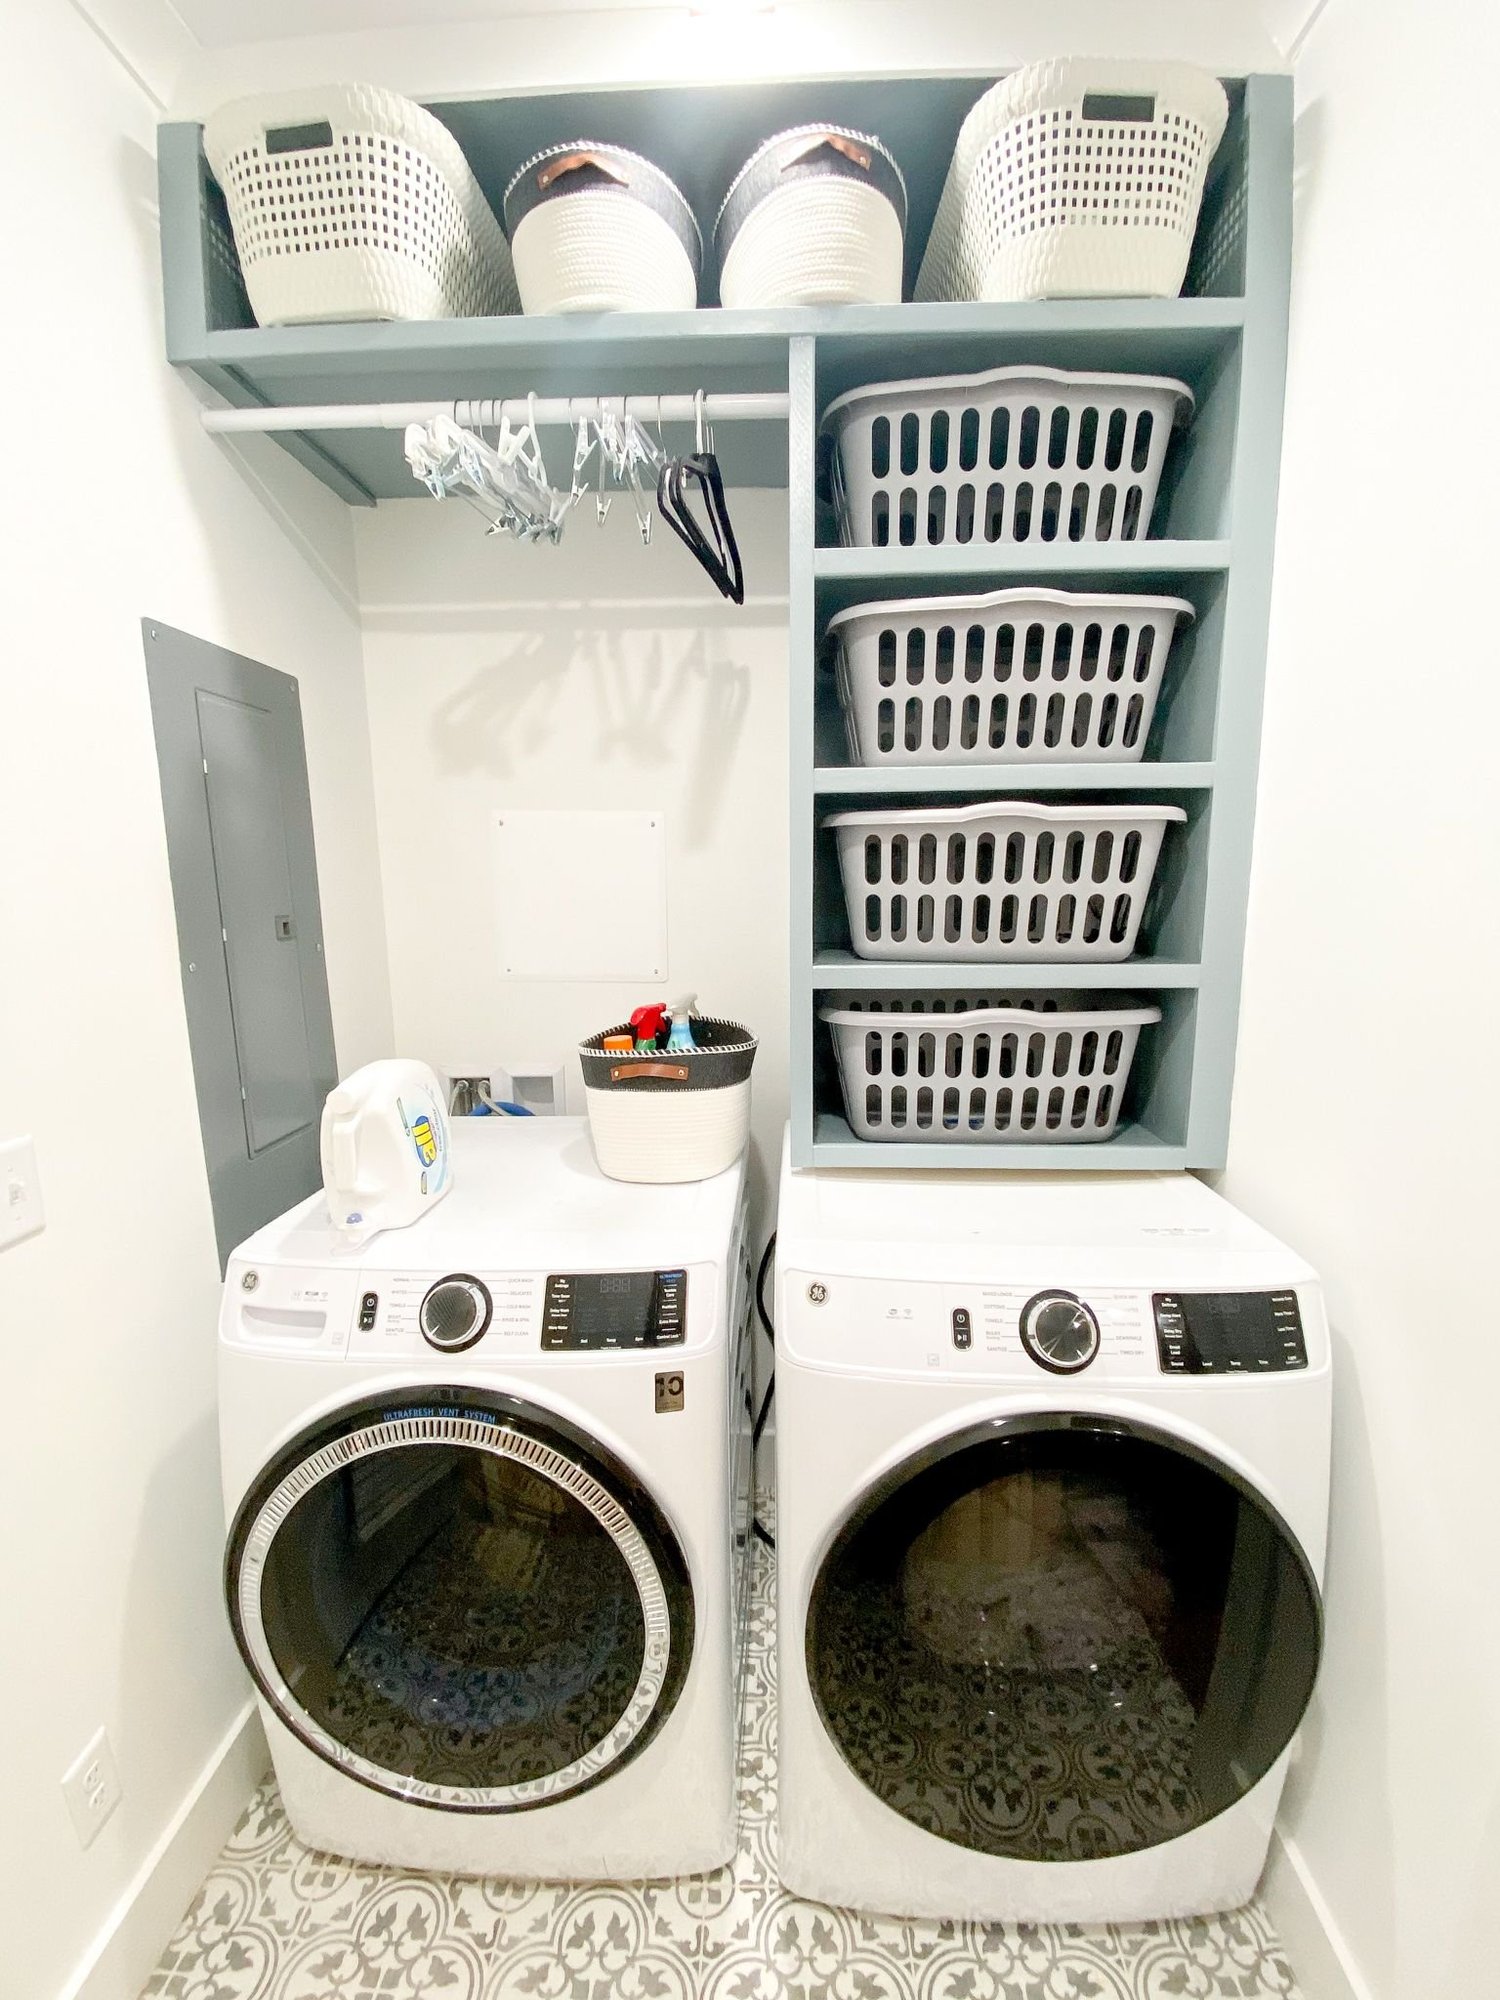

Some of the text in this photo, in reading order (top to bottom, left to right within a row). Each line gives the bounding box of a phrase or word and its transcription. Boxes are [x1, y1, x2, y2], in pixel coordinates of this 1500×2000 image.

[383, 1407, 496, 1425] ULTRAFRESH VENT SYSTEM
